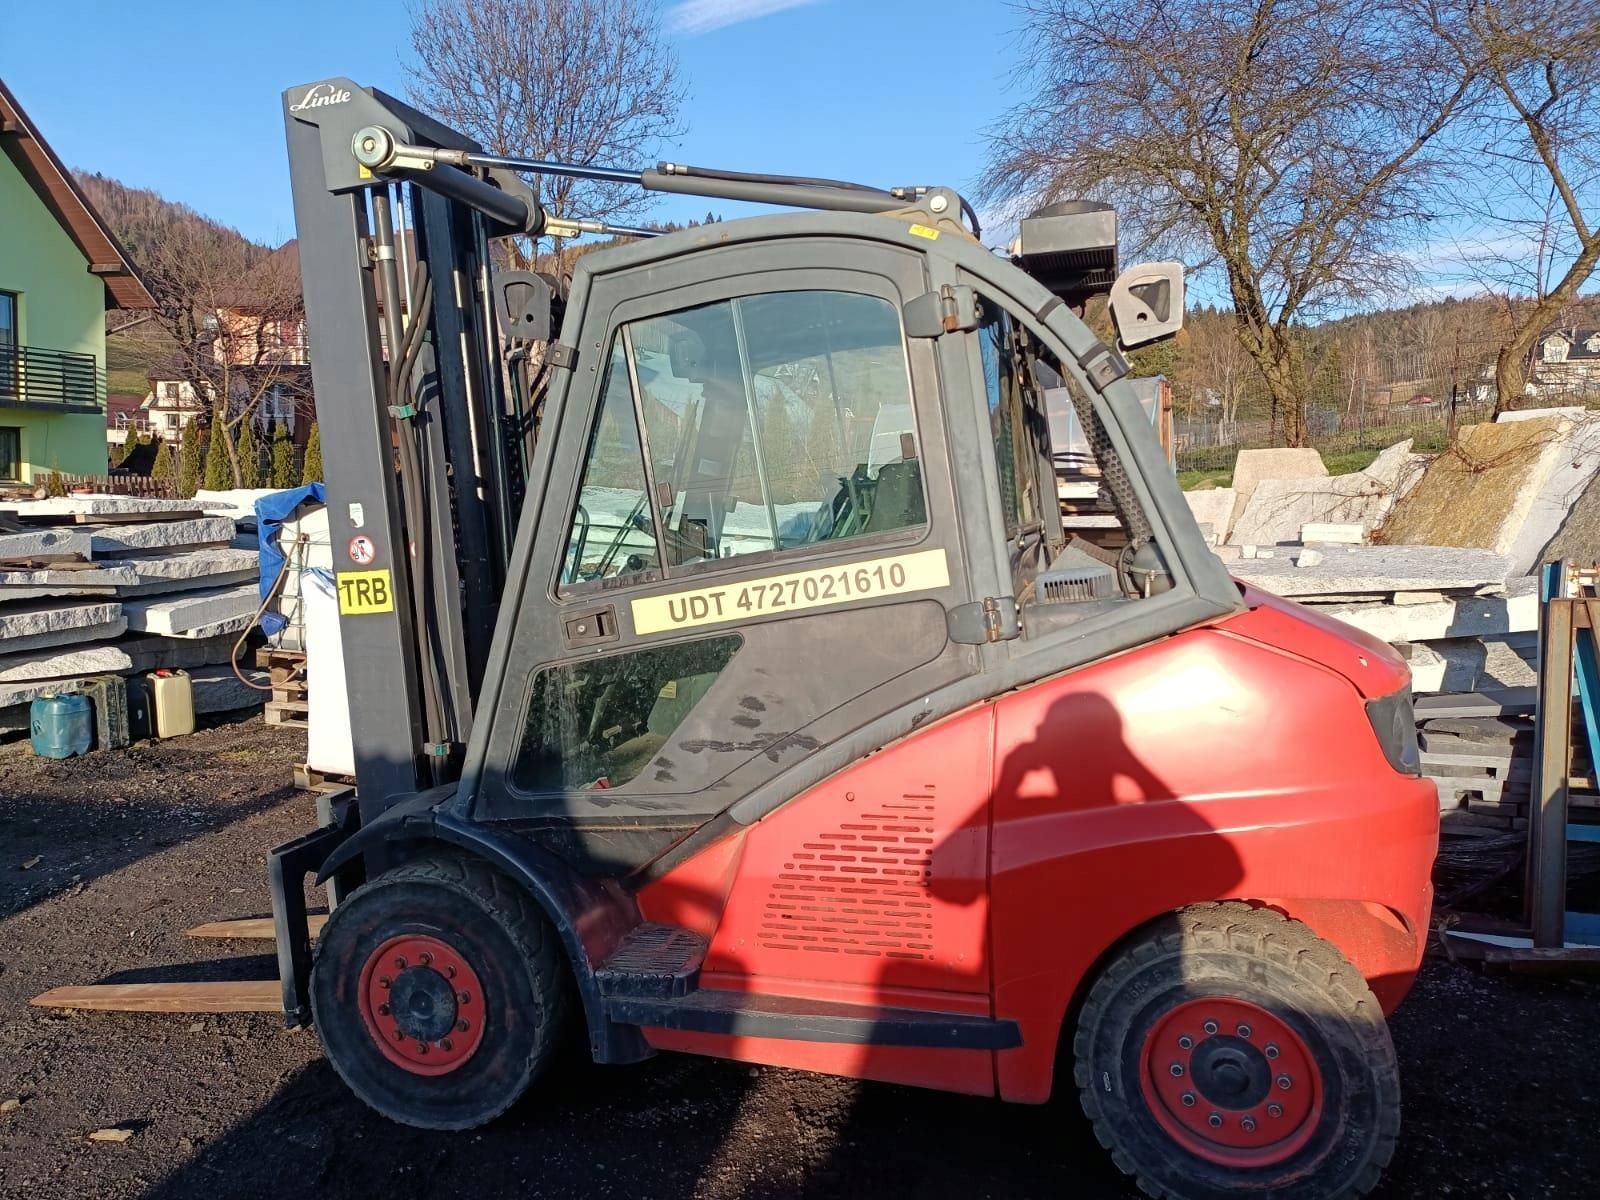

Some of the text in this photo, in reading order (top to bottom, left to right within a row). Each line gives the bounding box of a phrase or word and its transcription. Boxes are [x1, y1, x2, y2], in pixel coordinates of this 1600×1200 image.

[289, 84, 352, 112] Linde
[341, 577, 388, 607] TRB
[668, 562, 906, 623] UDT 4727021610
